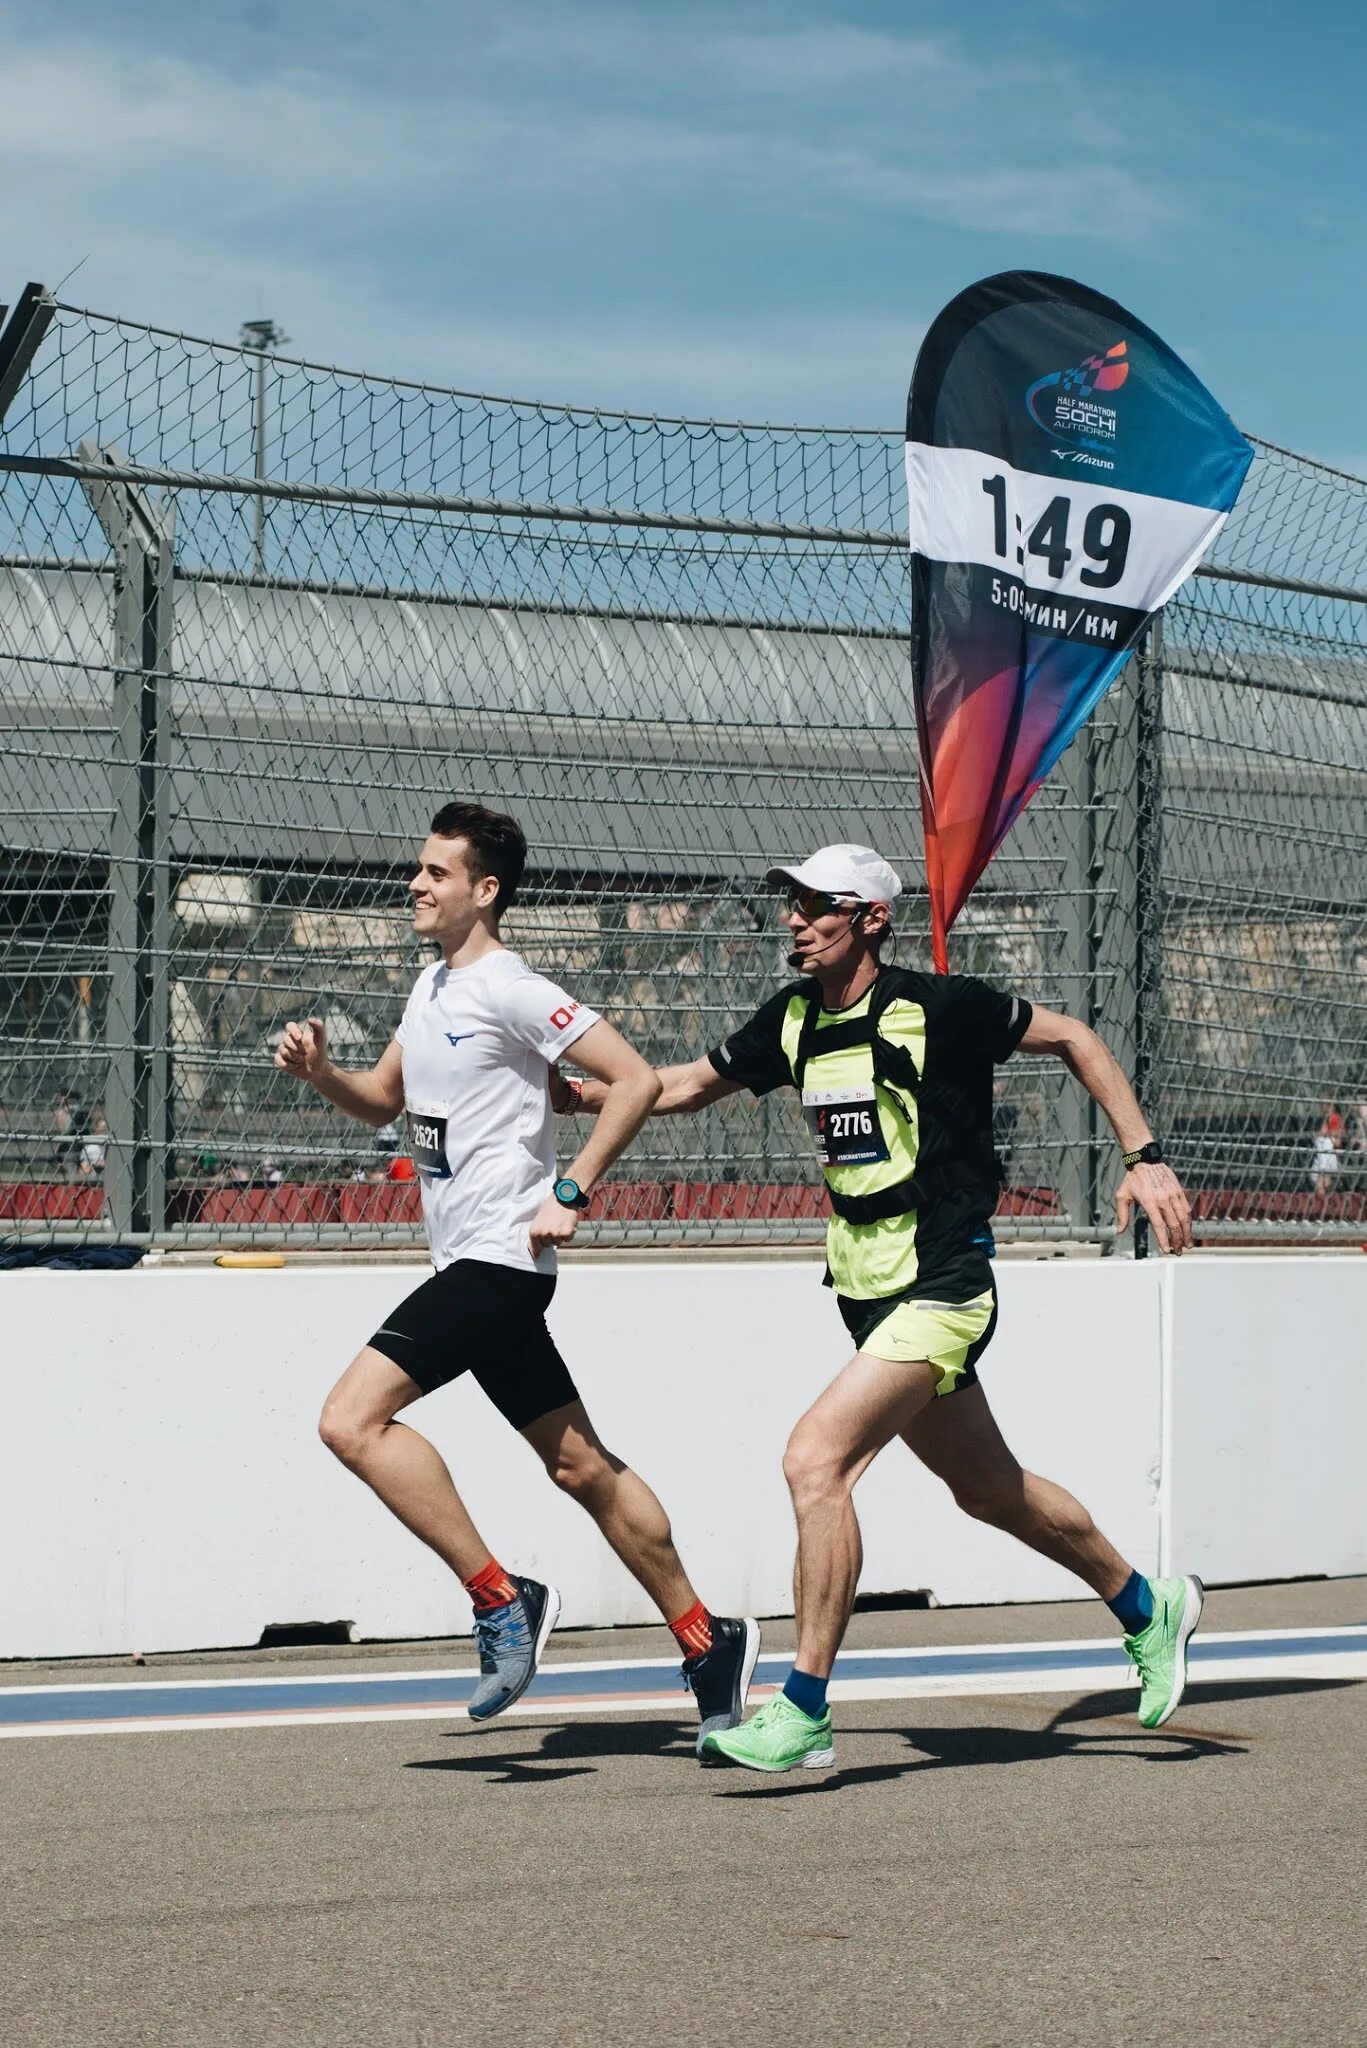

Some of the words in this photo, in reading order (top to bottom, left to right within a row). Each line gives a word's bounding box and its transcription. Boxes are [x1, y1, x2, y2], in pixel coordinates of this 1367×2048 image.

[1055, 406, 1116, 432] SOCHI
[1057, 396, 1076, 407] HALF
[1078, 401, 1117, 418] MARATHON
[1053, 420, 1116, 440] AUTODROM
[982, 474, 1132, 589] 1:49
[413, 1123, 439, 1151] 2621
[830, 1111, 873, 1137] 2776
